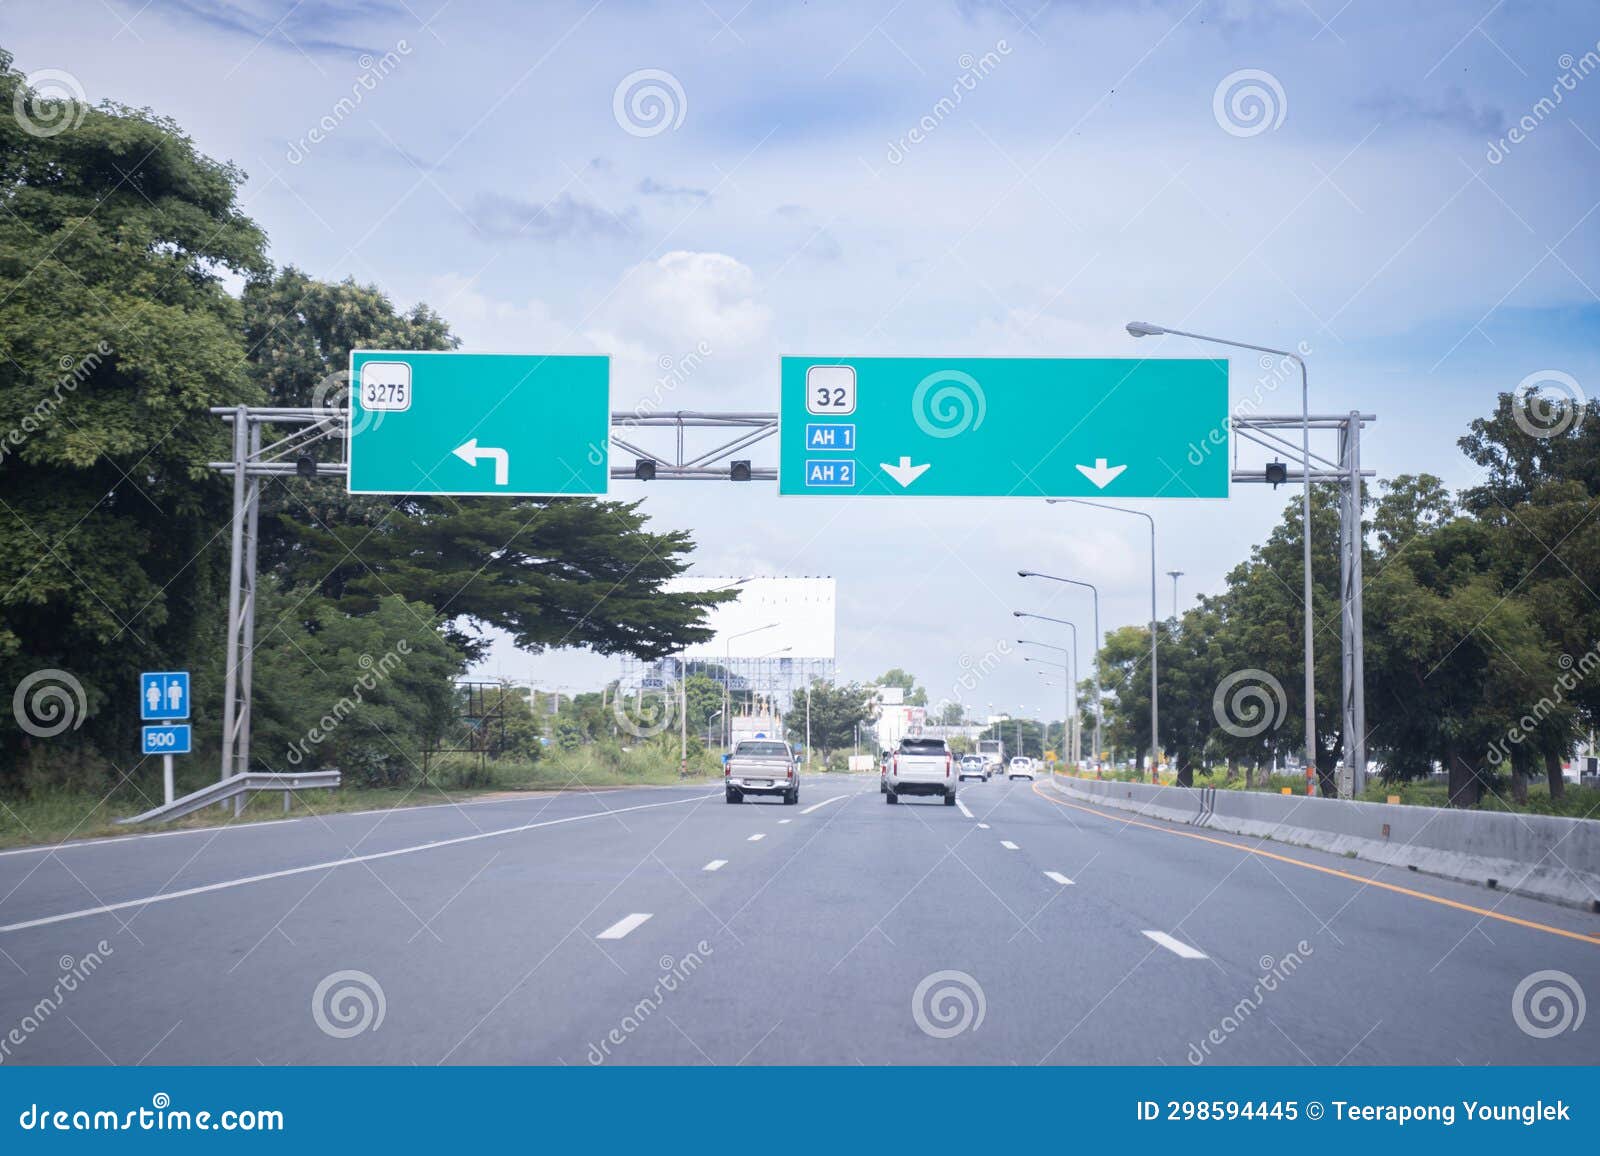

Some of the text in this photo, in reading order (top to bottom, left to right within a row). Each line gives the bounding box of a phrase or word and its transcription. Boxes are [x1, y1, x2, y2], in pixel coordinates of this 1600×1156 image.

[368, 384, 405, 402] 3275
[817, 388, 846, 407] 32
[811, 429, 850, 445] AH 1
[810, 465, 850, 481] AH 2
[147, 732, 175, 747] 500
